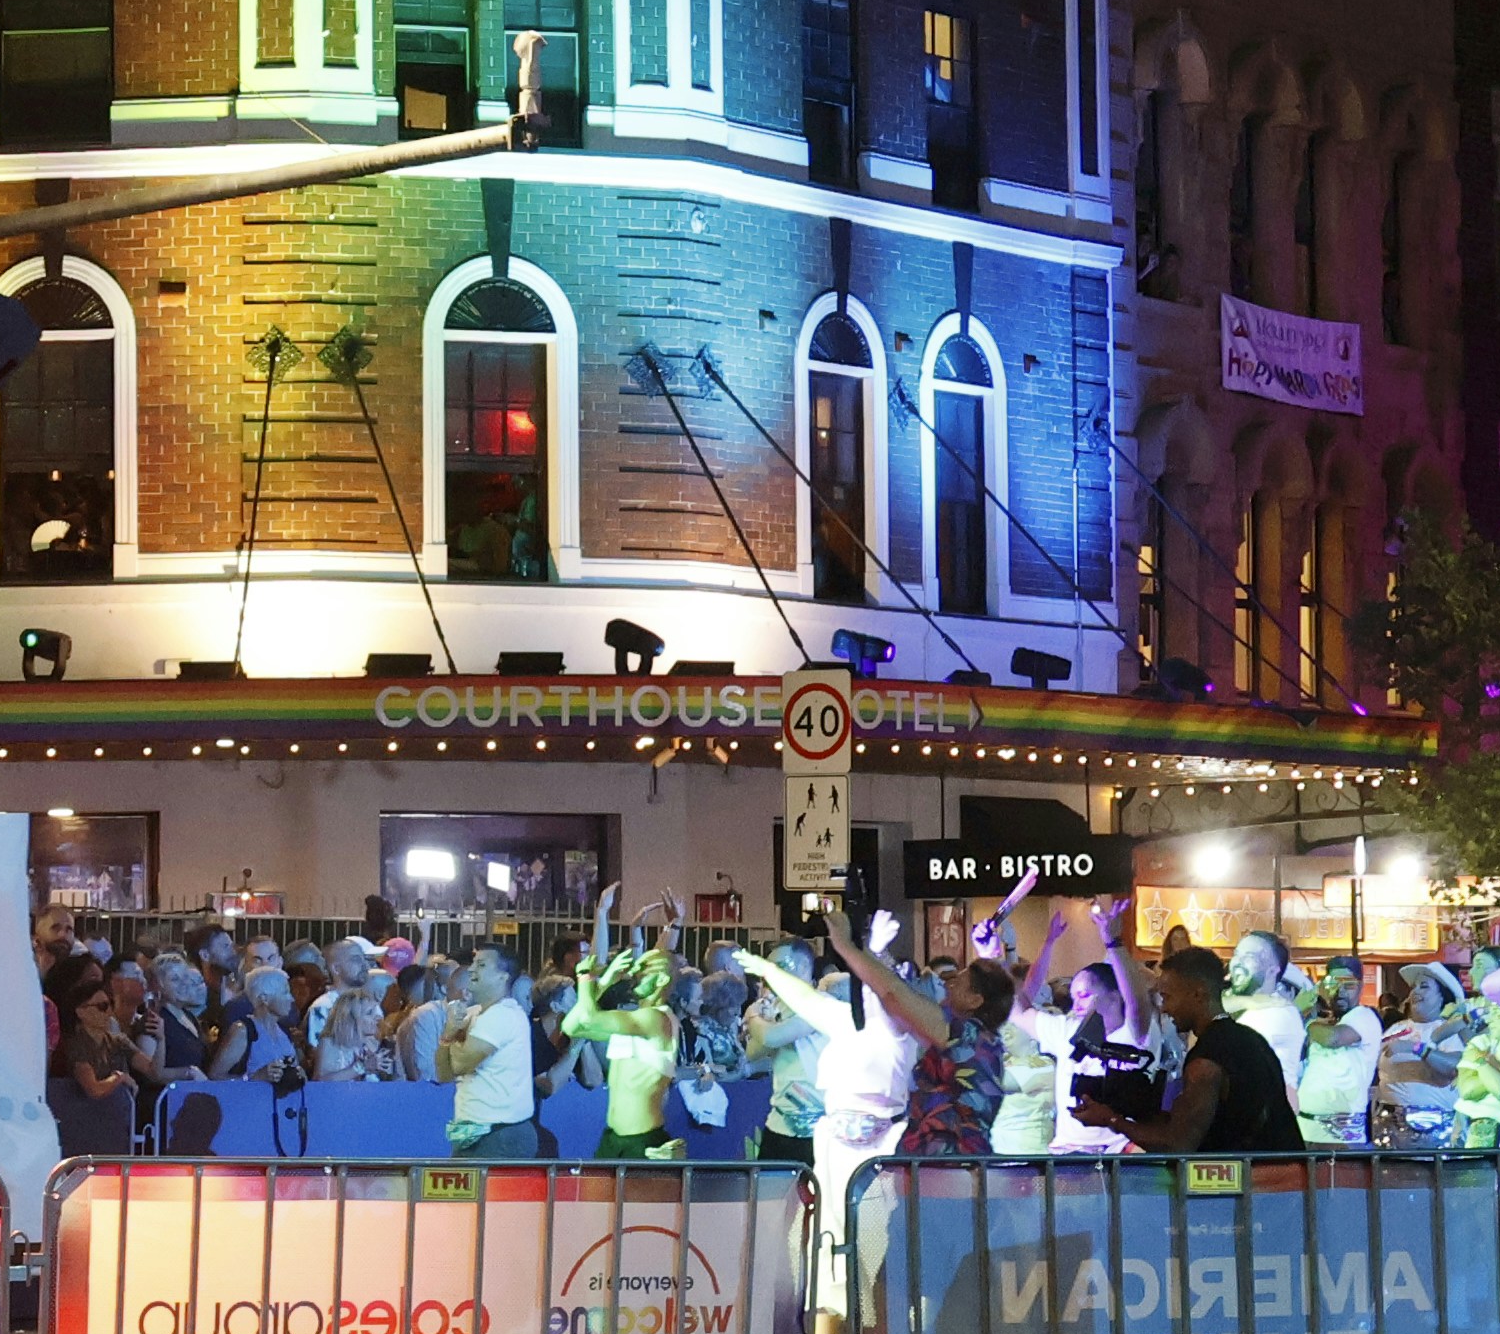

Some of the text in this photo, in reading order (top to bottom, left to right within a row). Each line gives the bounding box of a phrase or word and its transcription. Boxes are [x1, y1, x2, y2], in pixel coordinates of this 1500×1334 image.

[374, 684, 956, 734] COURTHOUSE OTEL
[794, 704, 840, 738] 40
[793, 862, 829, 872] PEDESTR
[929, 854, 1093, 880] BAR BISTRO
[429, 1172, 469, 1190] TFH
[1193, 1164, 1233, 1182] TFH
